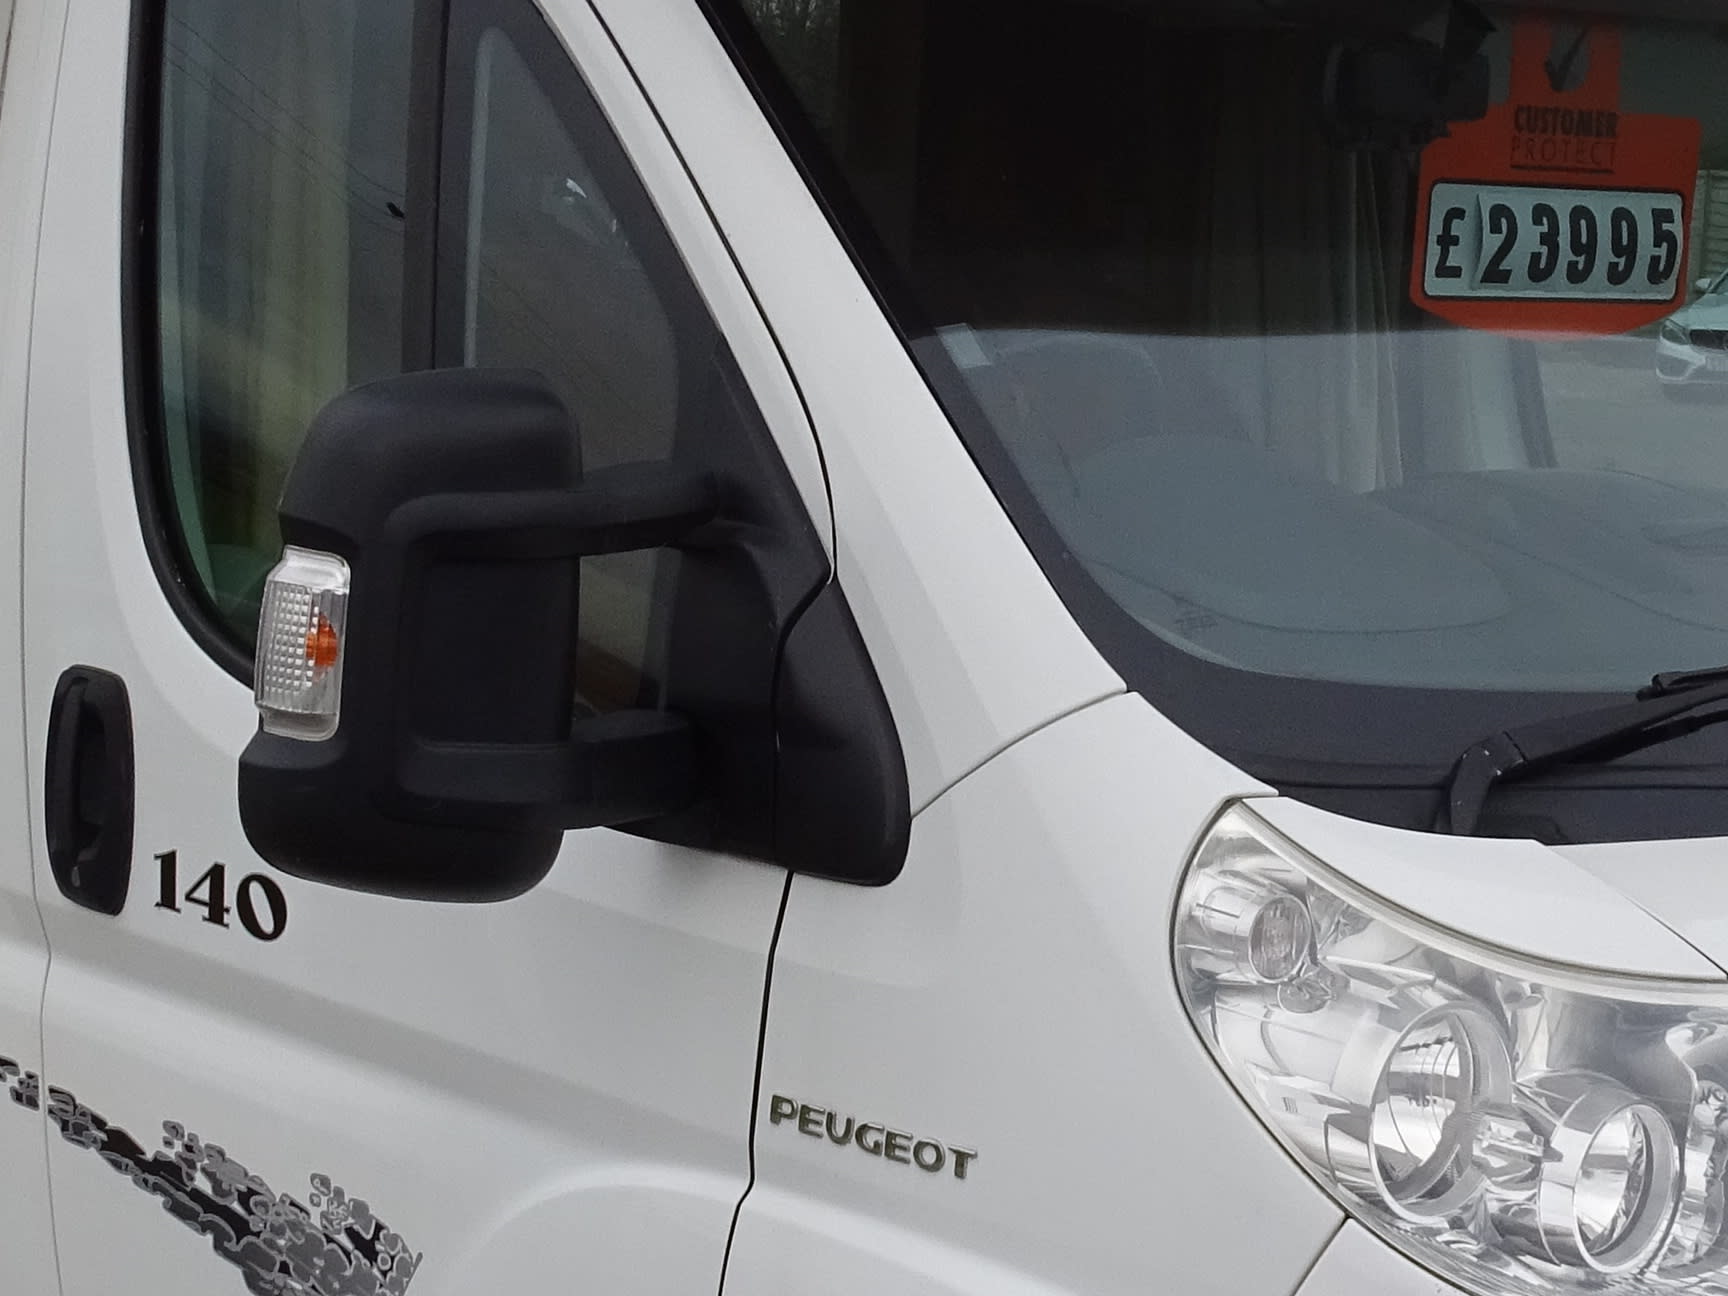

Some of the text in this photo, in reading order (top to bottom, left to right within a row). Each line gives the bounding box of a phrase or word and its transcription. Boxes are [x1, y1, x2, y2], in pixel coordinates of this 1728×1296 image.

[1513, 104, 1618, 138] CUSTOMER
[1510, 136, 1616, 167] PROTECT
[154, 849, 287, 942] 140
[769, 1093, 978, 1180] PEUGEOT
